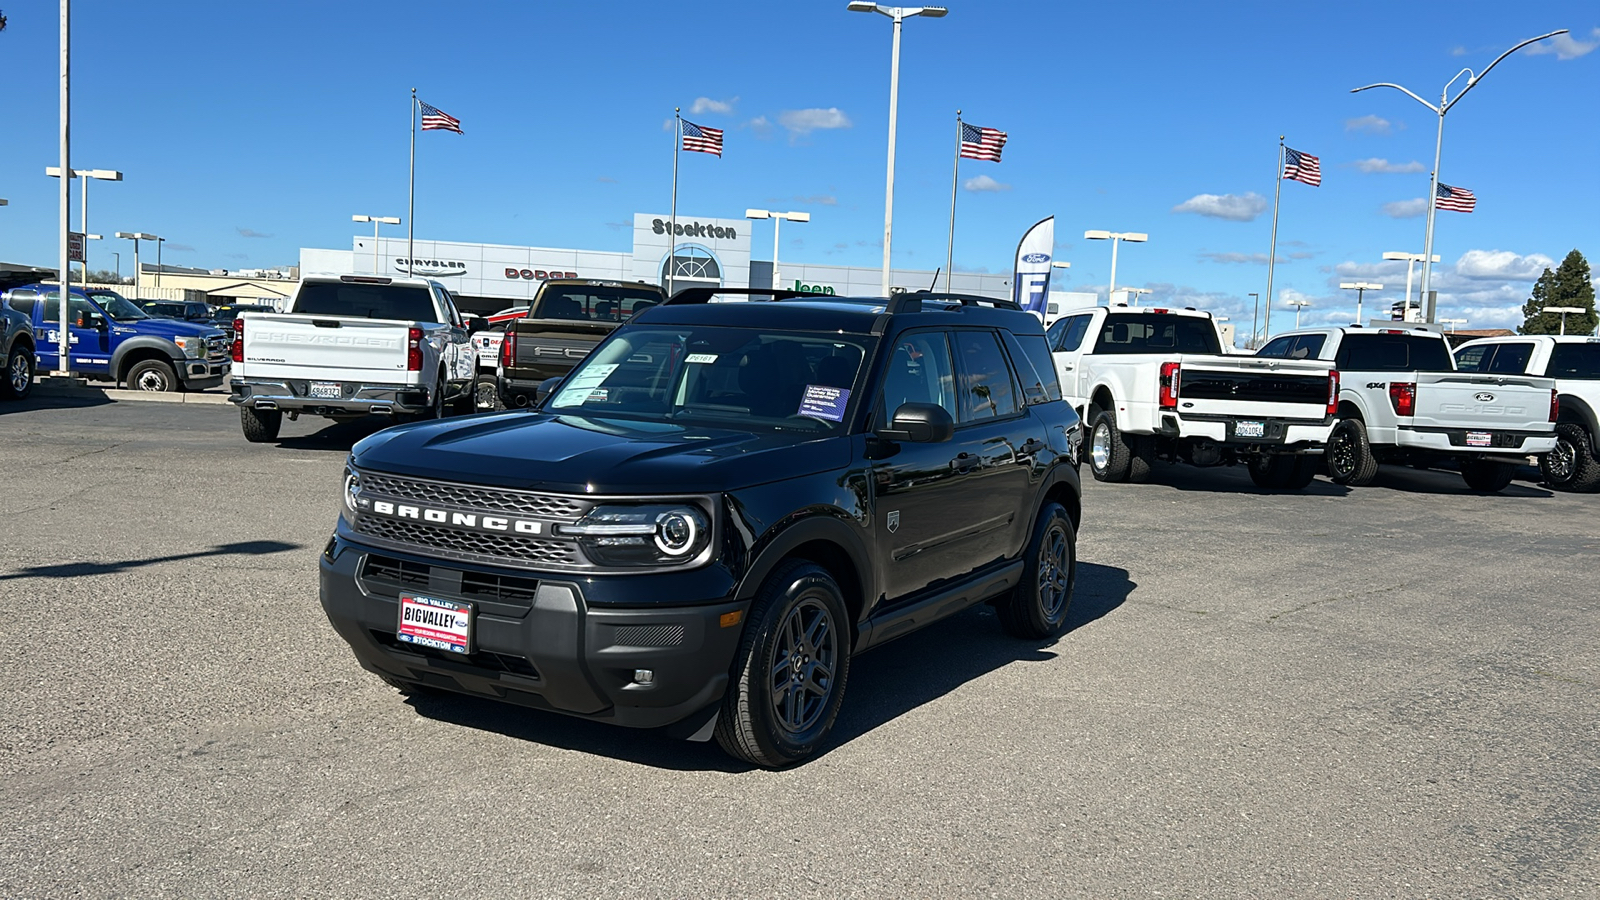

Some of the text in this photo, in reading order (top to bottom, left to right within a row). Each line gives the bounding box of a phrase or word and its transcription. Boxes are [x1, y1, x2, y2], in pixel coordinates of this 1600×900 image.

[652, 219, 736, 239] Stockton
[396, 258, 465, 268] CHRYSLER
[254, 332, 397, 347] CHEVROLET
[1440, 403, 1527, 416] F-150
[374, 501, 542, 534] BRONCO
[429, 600, 453, 608] VALLEY
[404, 607, 455, 628] BIGVALLEY
[413, 636, 451, 650] STOCKTON
